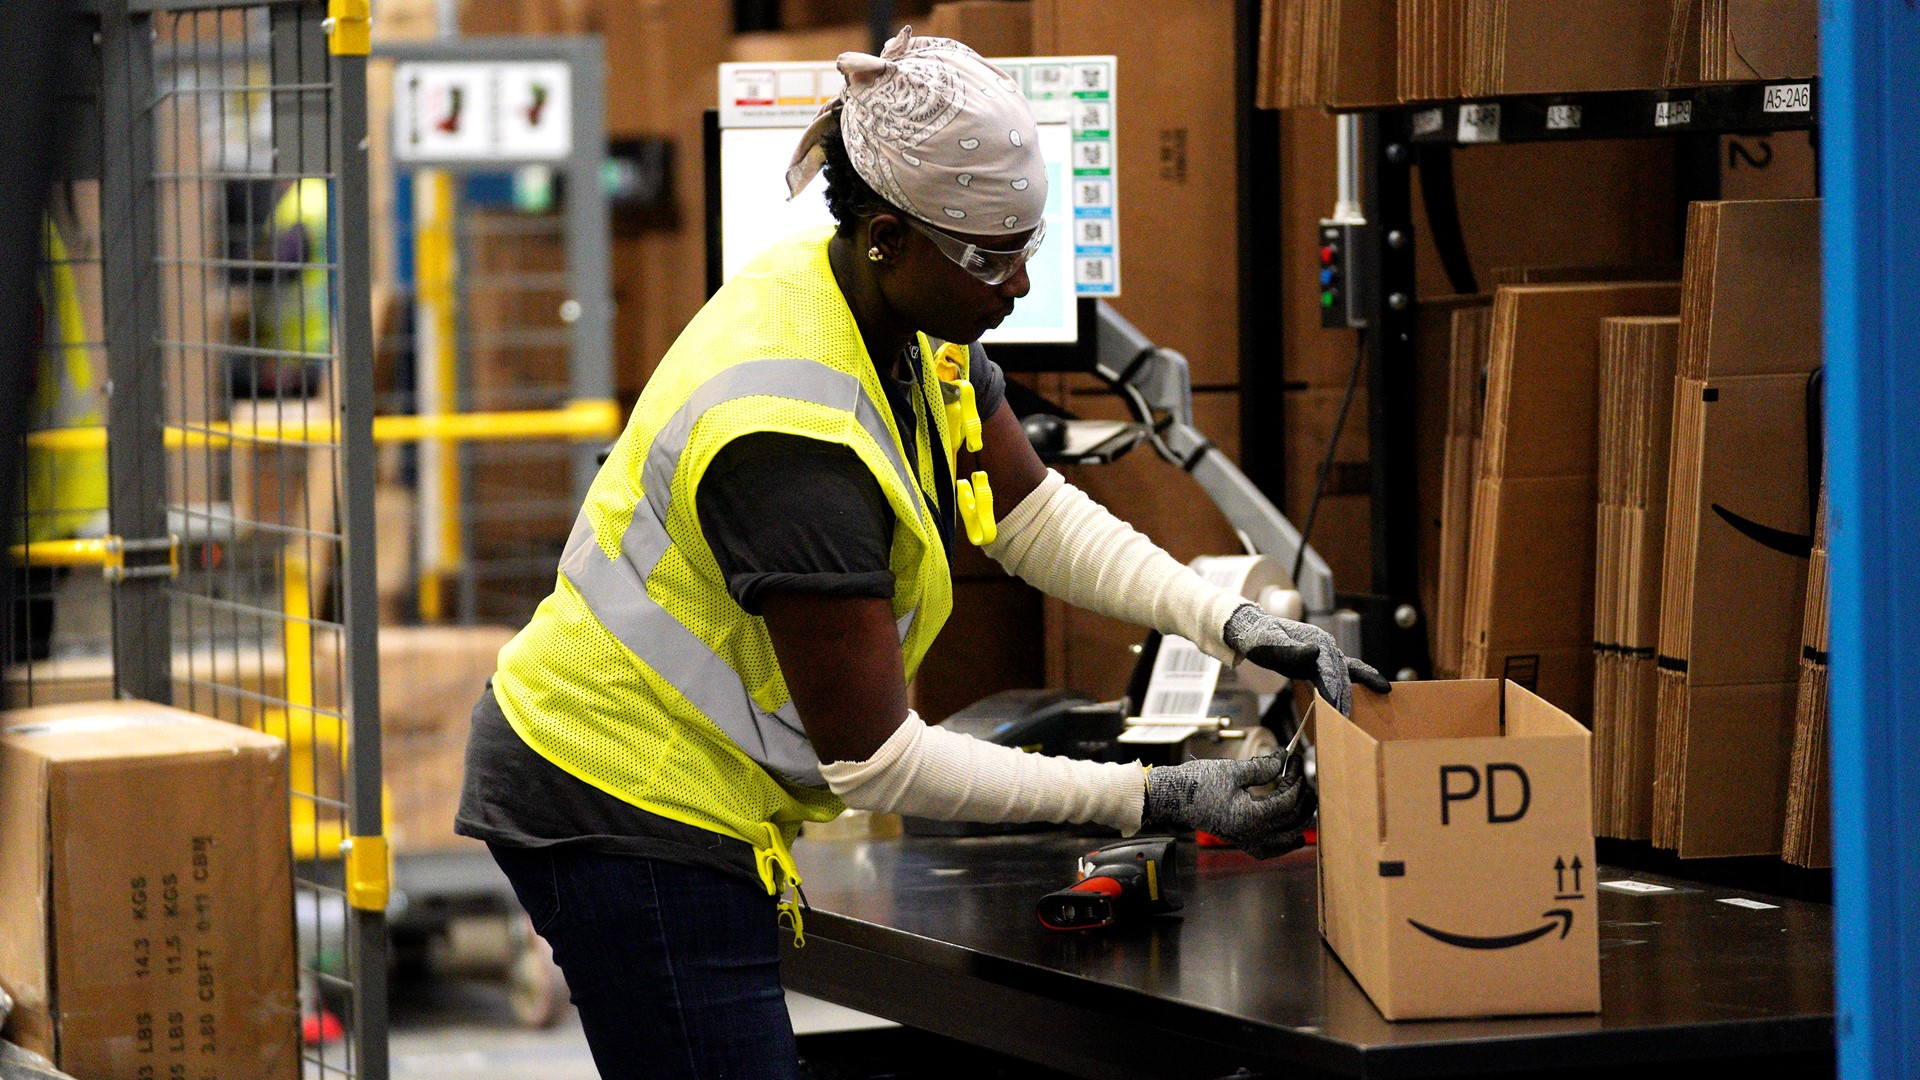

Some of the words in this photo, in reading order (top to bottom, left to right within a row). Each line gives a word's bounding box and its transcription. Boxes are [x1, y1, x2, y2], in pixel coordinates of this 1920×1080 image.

[1656, 101, 1690, 124] A4-P9
[1766, 86, 1808, 108] A5-2A6
[1440, 763, 1531, 825] PD
[131, 876, 148, 921] KGS
[162, 873, 180, 918] KGS
[134, 938, 150, 979] 14.3
[165, 934, 182, 976] 11.5
[197, 947, 215, 1002] CBFT
[136, 1012, 153, 1053] LBS
[168, 1011, 185, 1052] LBS
